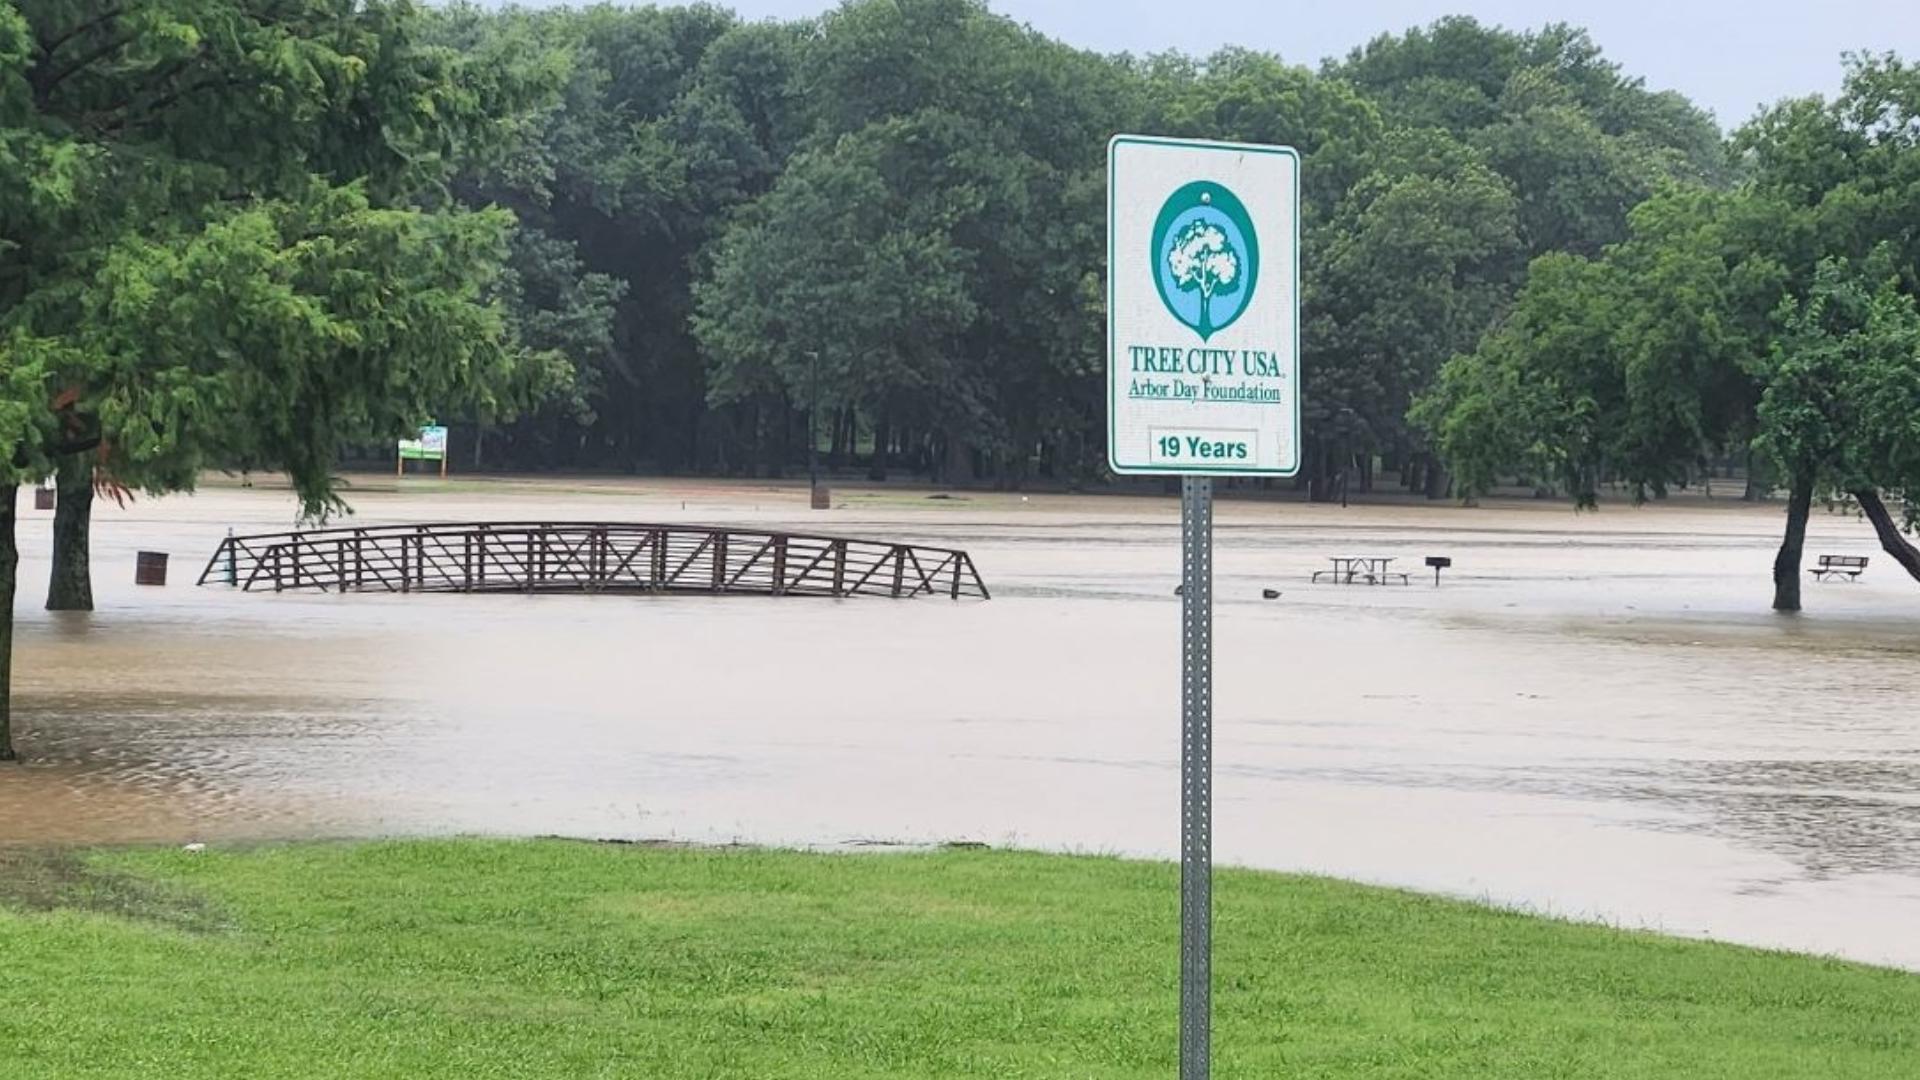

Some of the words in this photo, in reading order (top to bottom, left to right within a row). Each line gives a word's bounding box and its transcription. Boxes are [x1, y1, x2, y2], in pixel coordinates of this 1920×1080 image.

[1128, 346, 1183, 372] TREE
[1187, 348, 1236, 375] CITY
[1128, 378, 1169, 396] Arbor
[1173, 380, 1199, 404] Day
[1203, 379, 1281, 401] Foundation
[1158, 436, 1181, 457] 19
[1186, 436, 1247, 459] Years
